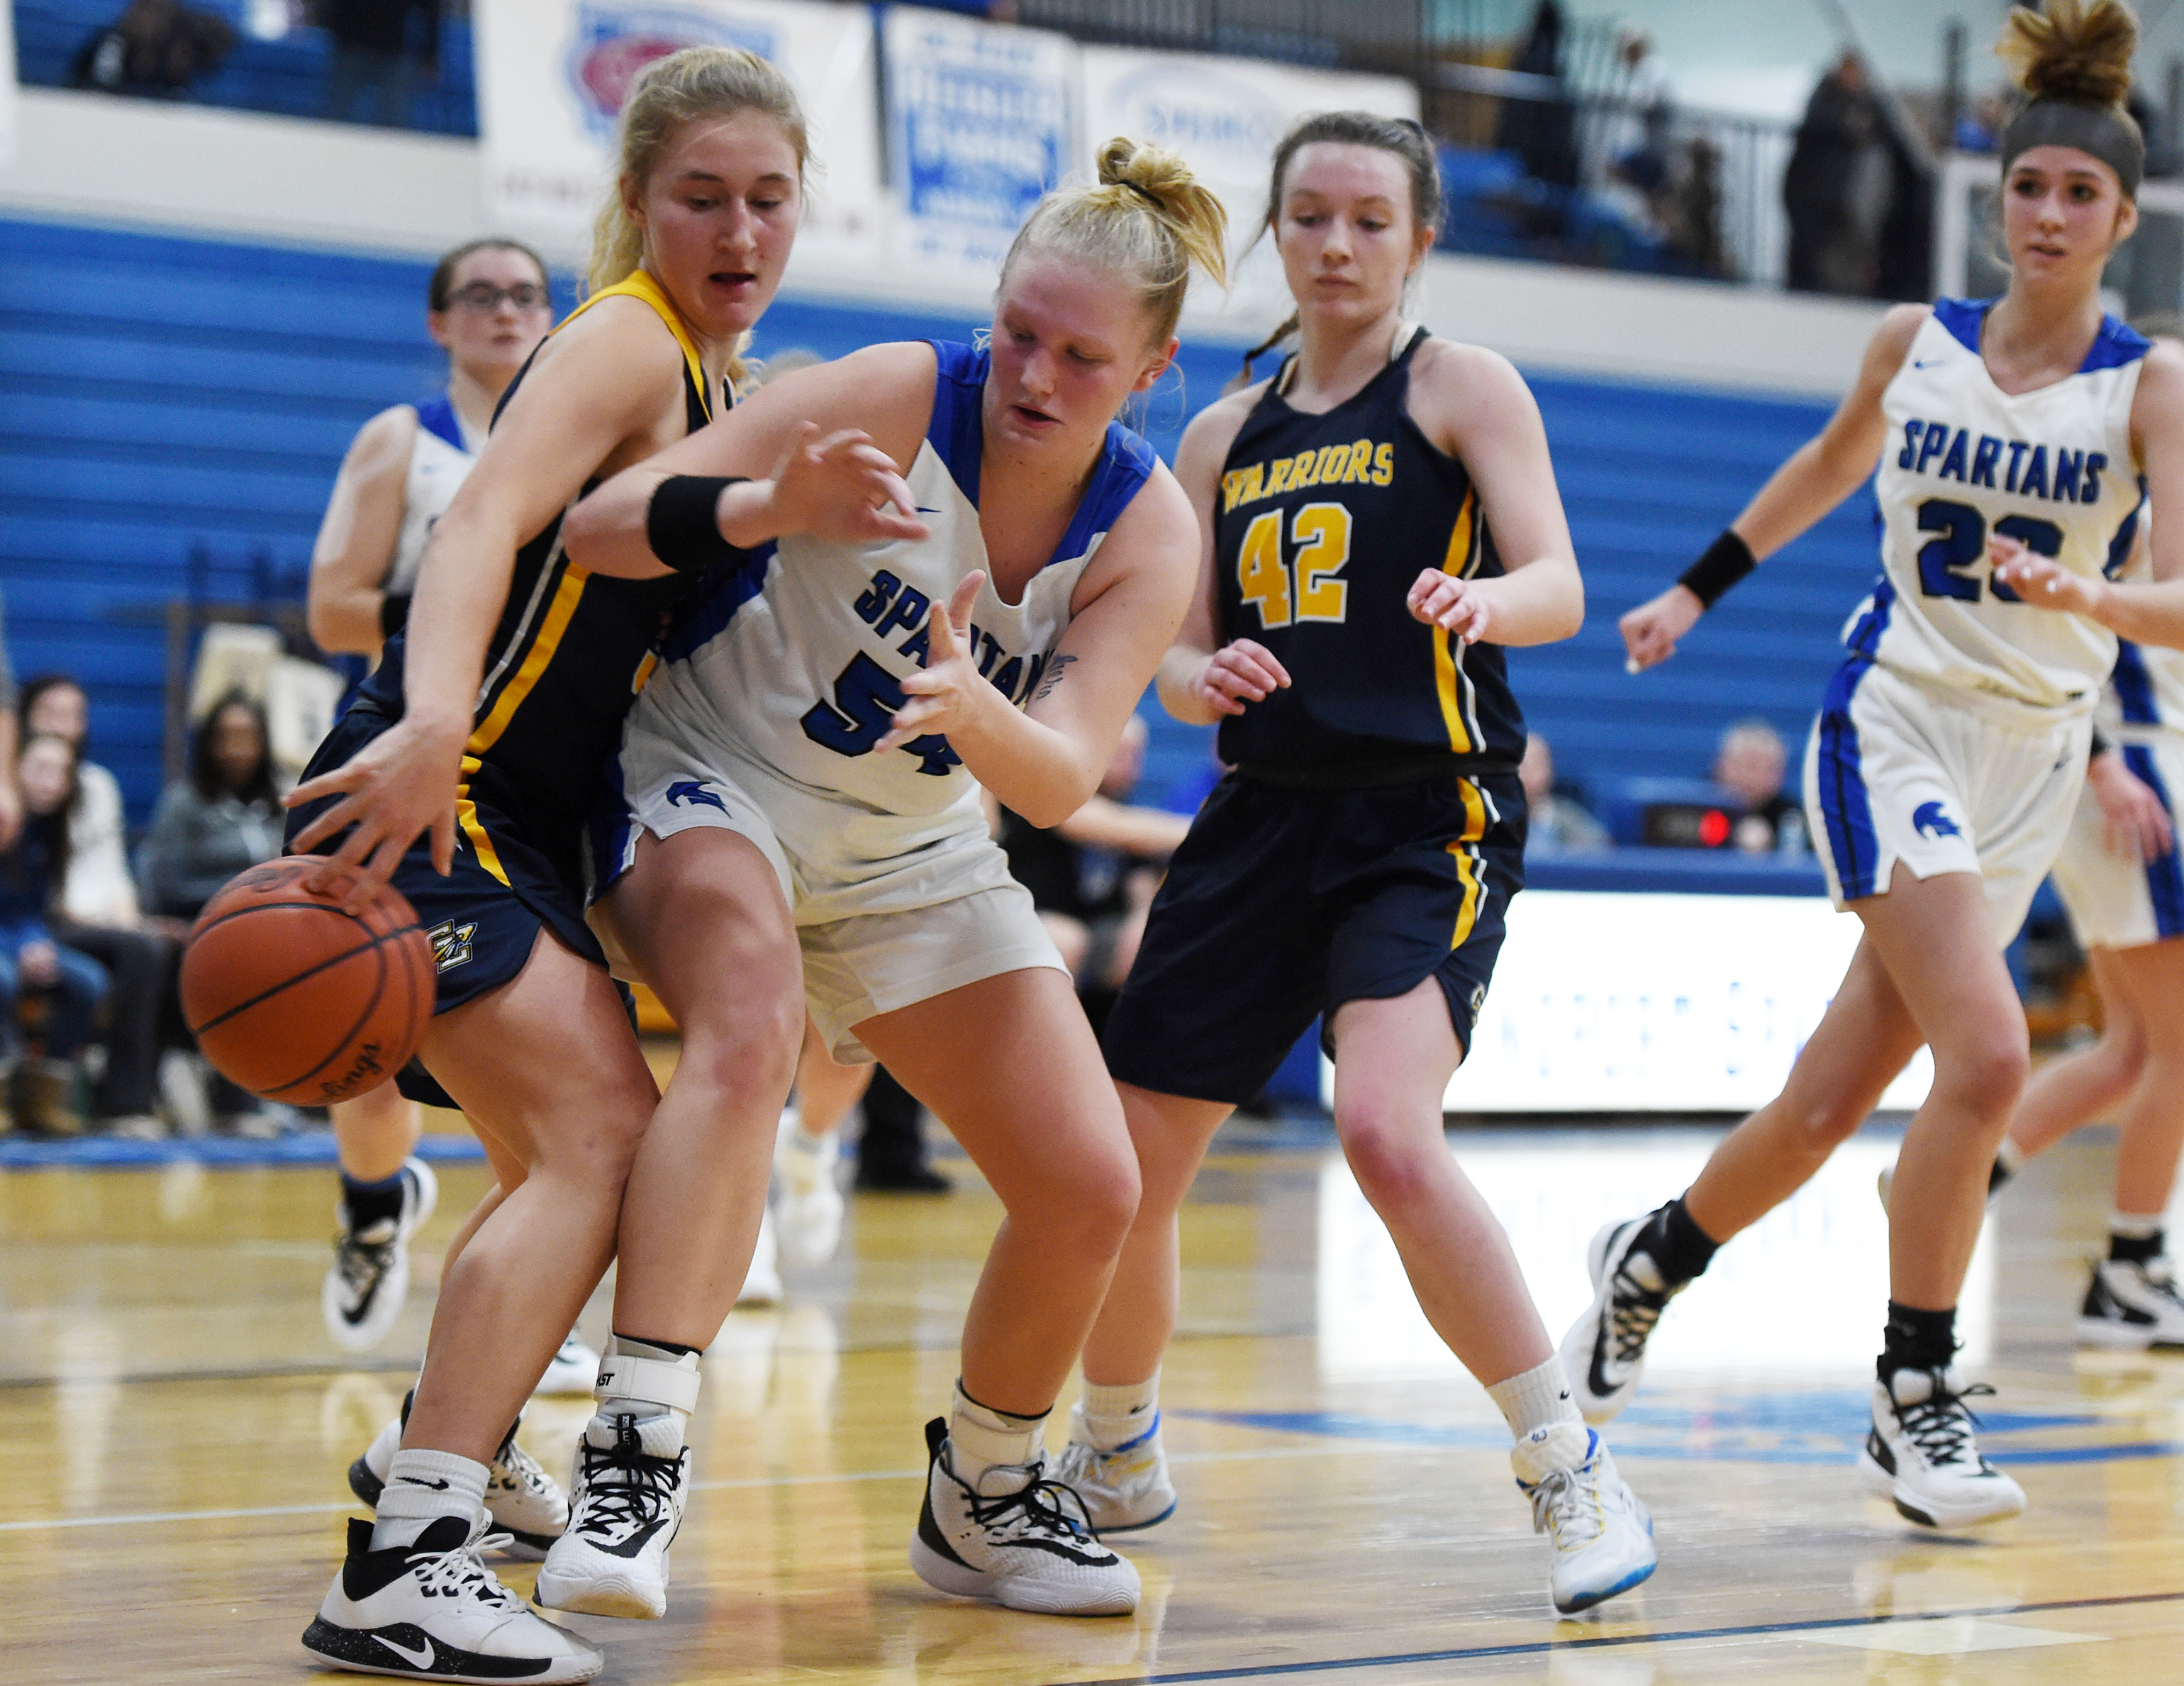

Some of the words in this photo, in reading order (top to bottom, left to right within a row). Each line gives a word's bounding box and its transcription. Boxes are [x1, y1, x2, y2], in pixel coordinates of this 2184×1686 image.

[1222, 438, 1395, 516] WARRIORS
[1898, 419, 2109, 506] SPARTANS
[1237, 501, 1354, 631] 42
[853, 569, 1055, 706] SPATAN
